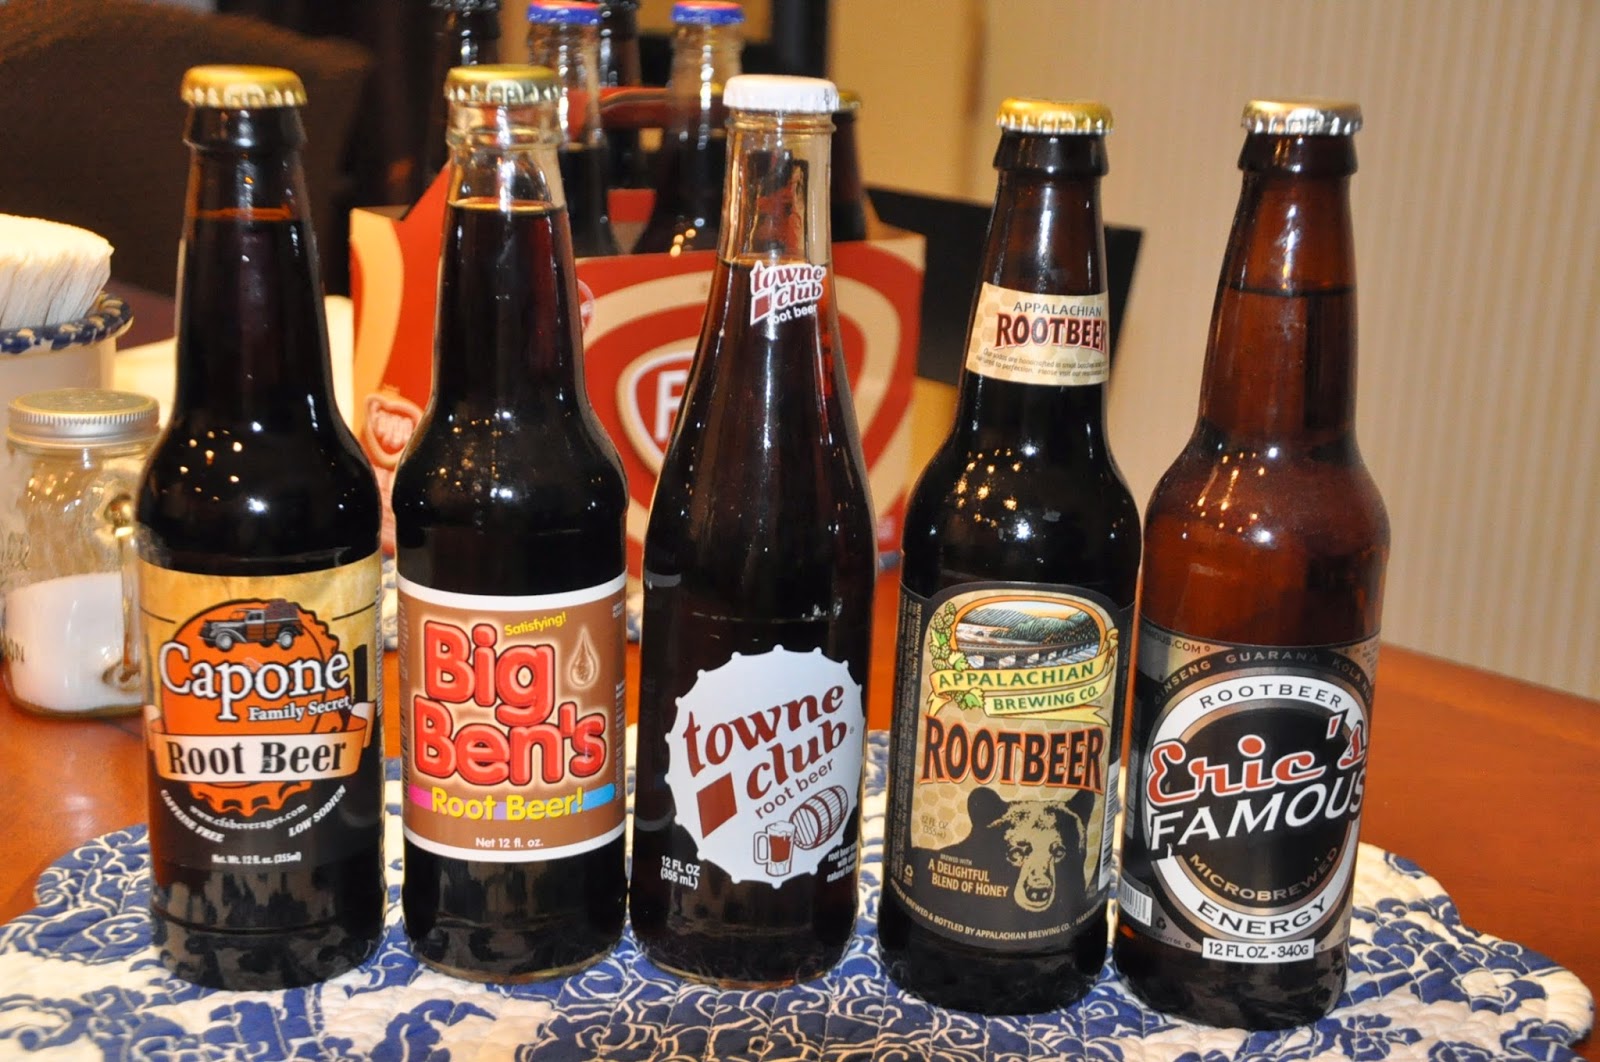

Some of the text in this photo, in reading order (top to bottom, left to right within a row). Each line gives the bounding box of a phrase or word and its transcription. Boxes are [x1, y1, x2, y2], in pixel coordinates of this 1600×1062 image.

[751, 260, 826, 295] towne
[775, 281, 823, 309] club
[793, 304, 817, 318] beer
[1013, 301, 1102, 317] APPALACHIAN
[504, 611, 567, 637] Satisfying!
[158, 640, 350, 721] Capone
[424, 620, 555, 727] Big
[939, 661, 1094, 690] APPALACHIAN
[1155, 660, 1212, 706] GINSENG
[248, 702, 305, 722] Family
[993, 686, 1099, 712] BREWING CO.
[1199, 684, 1342, 709] ROOTBEER
[414, 695, 606, 786] Ben's
[683, 685, 844, 777] towne
[165, 739, 347, 775] Root Beer
[746, 719, 847, 800] club
[919, 713, 1105, 795] ROOTBEER
[1147, 711, 1366, 807] Eric's
[431, 786, 583, 821] Root Beer!
[755, 757, 833, 819] root beer
[160, 789, 226, 843] CAFFEINE FREE
[287, 784, 347, 838] LOW SODIUM
[1150, 769, 1366, 852] FAMOUS
[242, 855, 253, 865] 12
[475, 836, 544, 849] Net 12 fl. oz.
[660, 866, 699, 891] (355 mL)
[661, 855, 700, 877] 12 FL OZ
[928, 858, 990, 882] A DELIGHTFUL
[1189, 846, 1339, 901] MICROBREWED
[931, 872, 1009, 897] BLEND OF HONEY
[905, 895, 928, 918] BREWED
[933, 914, 964, 934] BOTTLED
[964, 926, 976, 937] BY
[975, 928, 1028, 940] APPALACHIAN
[1028, 924, 1061, 939] BREWING
[1197, 895, 1327, 936] ENERGY
[1208, 942, 1223, 956] 12
[1226, 944, 1244, 958] FL
[1246, 946, 1268, 959] OZ
[1277, 943, 1309, 958] 340G
